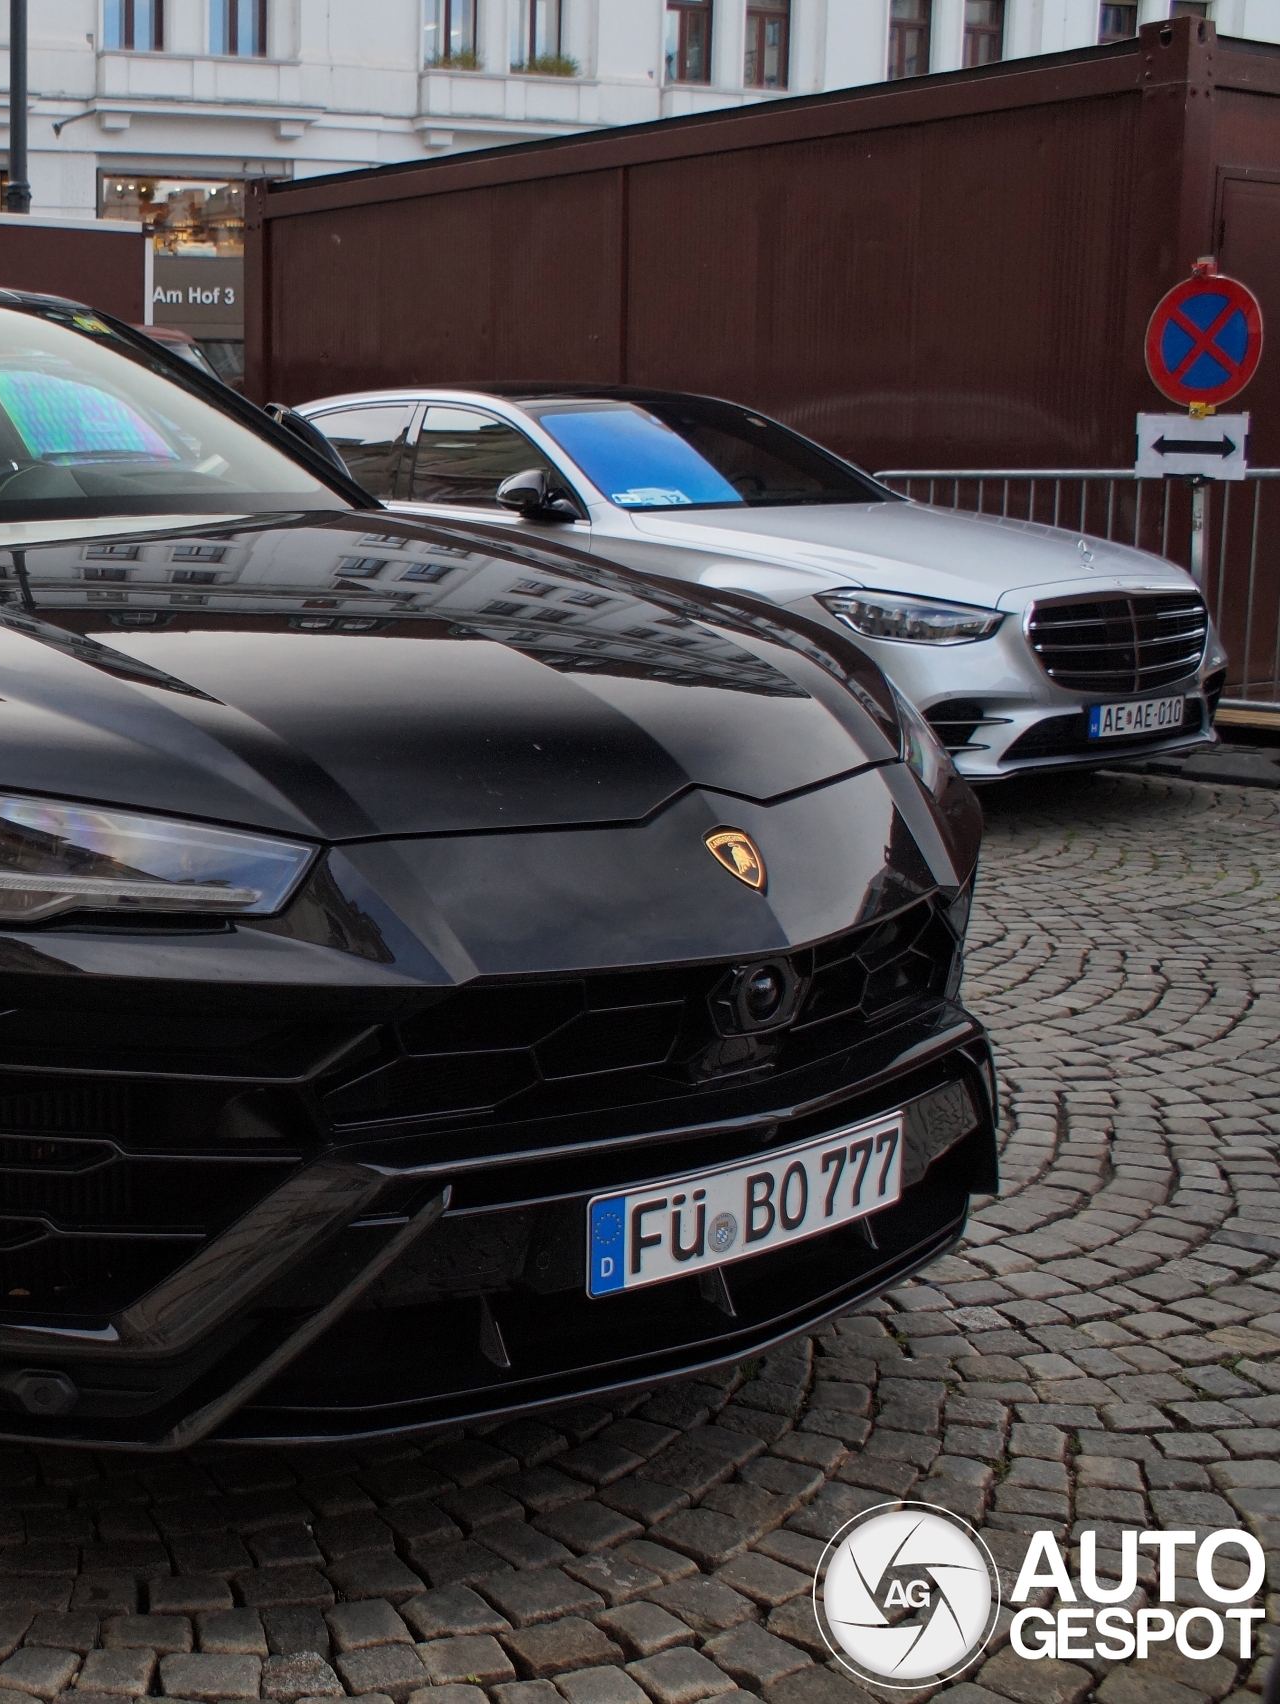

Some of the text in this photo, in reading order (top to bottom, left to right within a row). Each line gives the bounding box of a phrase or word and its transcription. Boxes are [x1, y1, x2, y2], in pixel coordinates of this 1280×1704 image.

[152, 285, 235, 305] Am Hof 3
[1090, 723, 1098, 733] H
[1102, 706, 1125, 733] AE
[629, 1126, 899, 1275] FÜ BO 777
[599, 1256, 614, 1279] D
